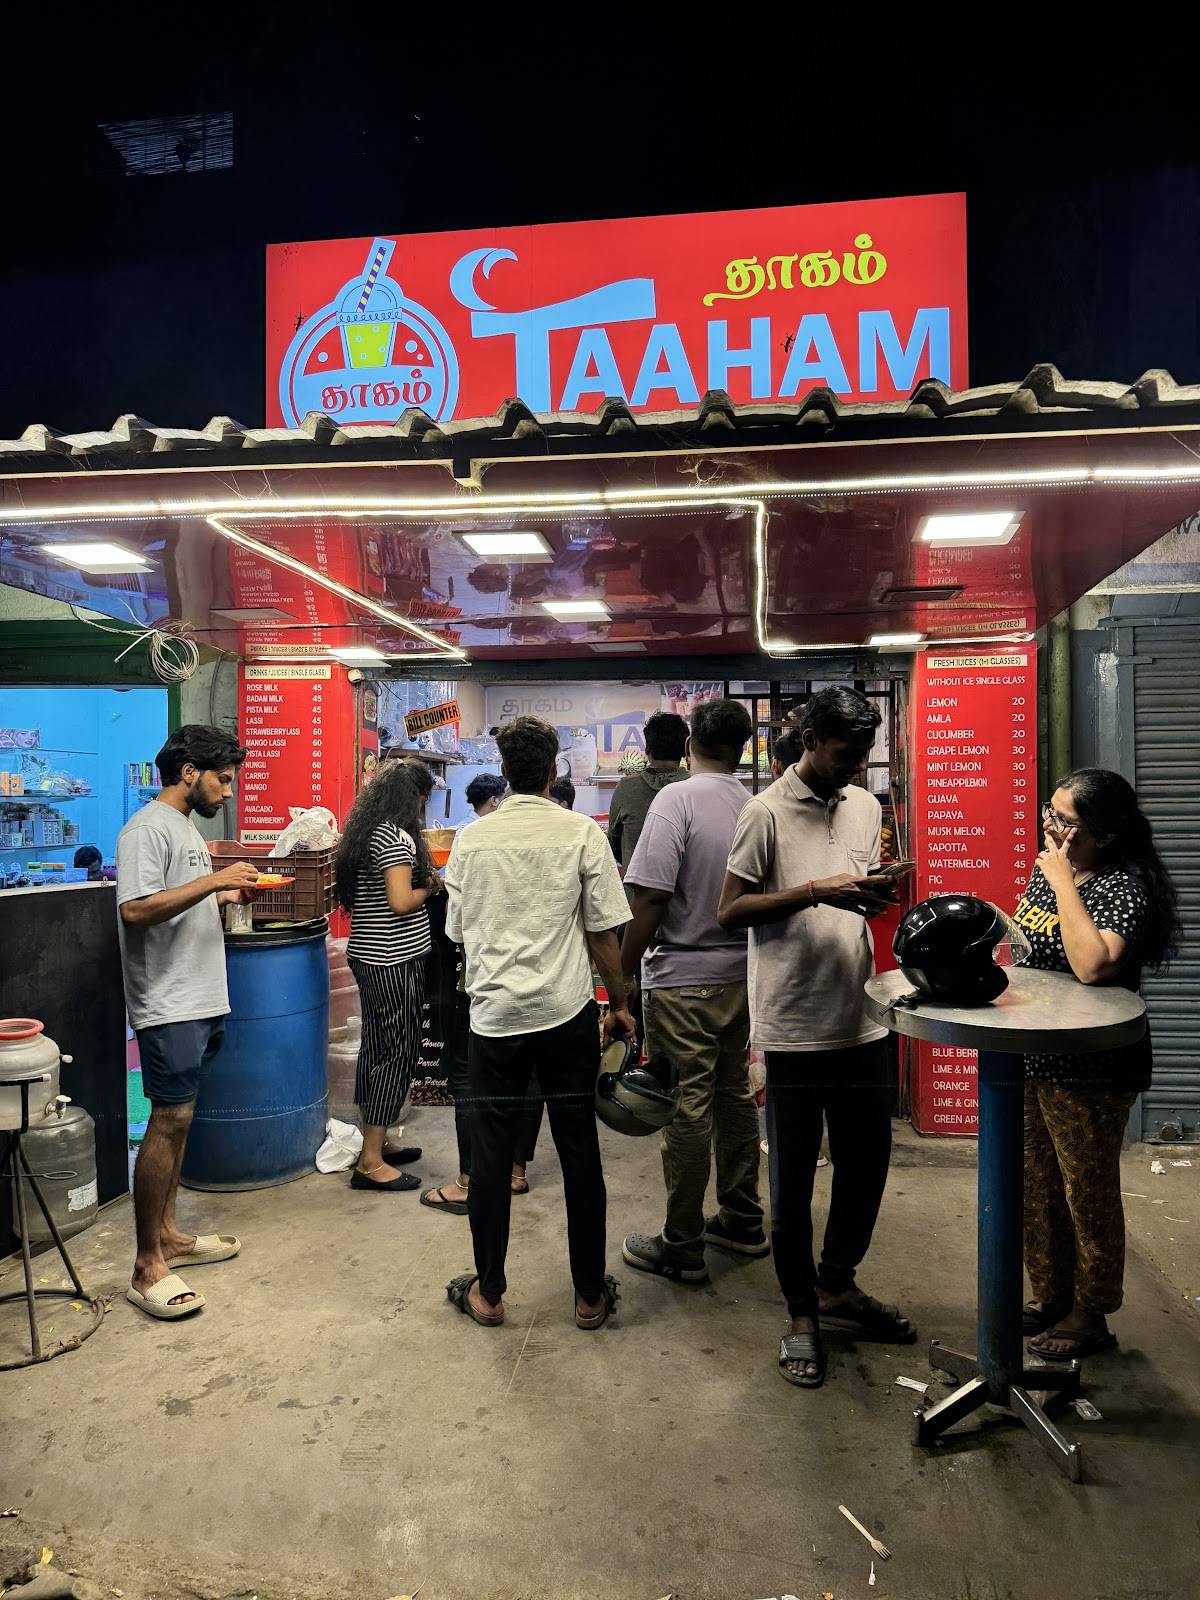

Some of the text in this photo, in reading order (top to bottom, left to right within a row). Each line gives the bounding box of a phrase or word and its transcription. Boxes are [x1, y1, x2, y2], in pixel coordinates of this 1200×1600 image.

[703, 234, 887, 306] தாகம்
[471, 278, 950, 414] TAAHAM
[321, 369, 432, 414] தாகம்
[933, 659, 954, 667] FRESH
[956, 658, 977, 666] JUICES
[990, 657, 1021, 666] GLASSES)
[928, 676, 1025, 686] WITHOUT ICE SINGLE GLASS
[927, 697, 1025, 707] LEMON 20
[407, 705, 458, 732] BILL COUNTER
[927, 714, 1025, 724] AMLA 20
[927, 730, 1025, 740] CUCUMBER 20
[927, 746, 1025, 756] GRAPE LEMON 30
[927, 762, 1025, 771] MINT LEMON 30
[312, 772, 321, 780] 60
[1012, 778, 1026, 787] 30
[928, 794, 1026, 804] GUAVA 30
[928, 811, 1025, 820] PAPAYA 35
[928, 827, 1025, 836] MUSK MELON 45
[928, 843, 1025, 852] SAPOTTA 45
[928, 859, 1026, 868] WATERMELON 45
[929, 875, 1026, 885] FIG 45
[422, 1038, 444, 1049] Honey
[932, 1048, 954, 1057] BLUE
[417, 1057, 440, 1067] Parcel
[932, 1064, 952, 1073] LIME
[955, 1065, 961, 1074] &
[425, 1077, 448, 1086] Parcel
[933, 1081, 970, 1091] ORANGE
[933, 1098, 953, 1107] LIME
[955, 1098, 962, 1107] &
[934, 1114, 978, 1124] GREEN AP
